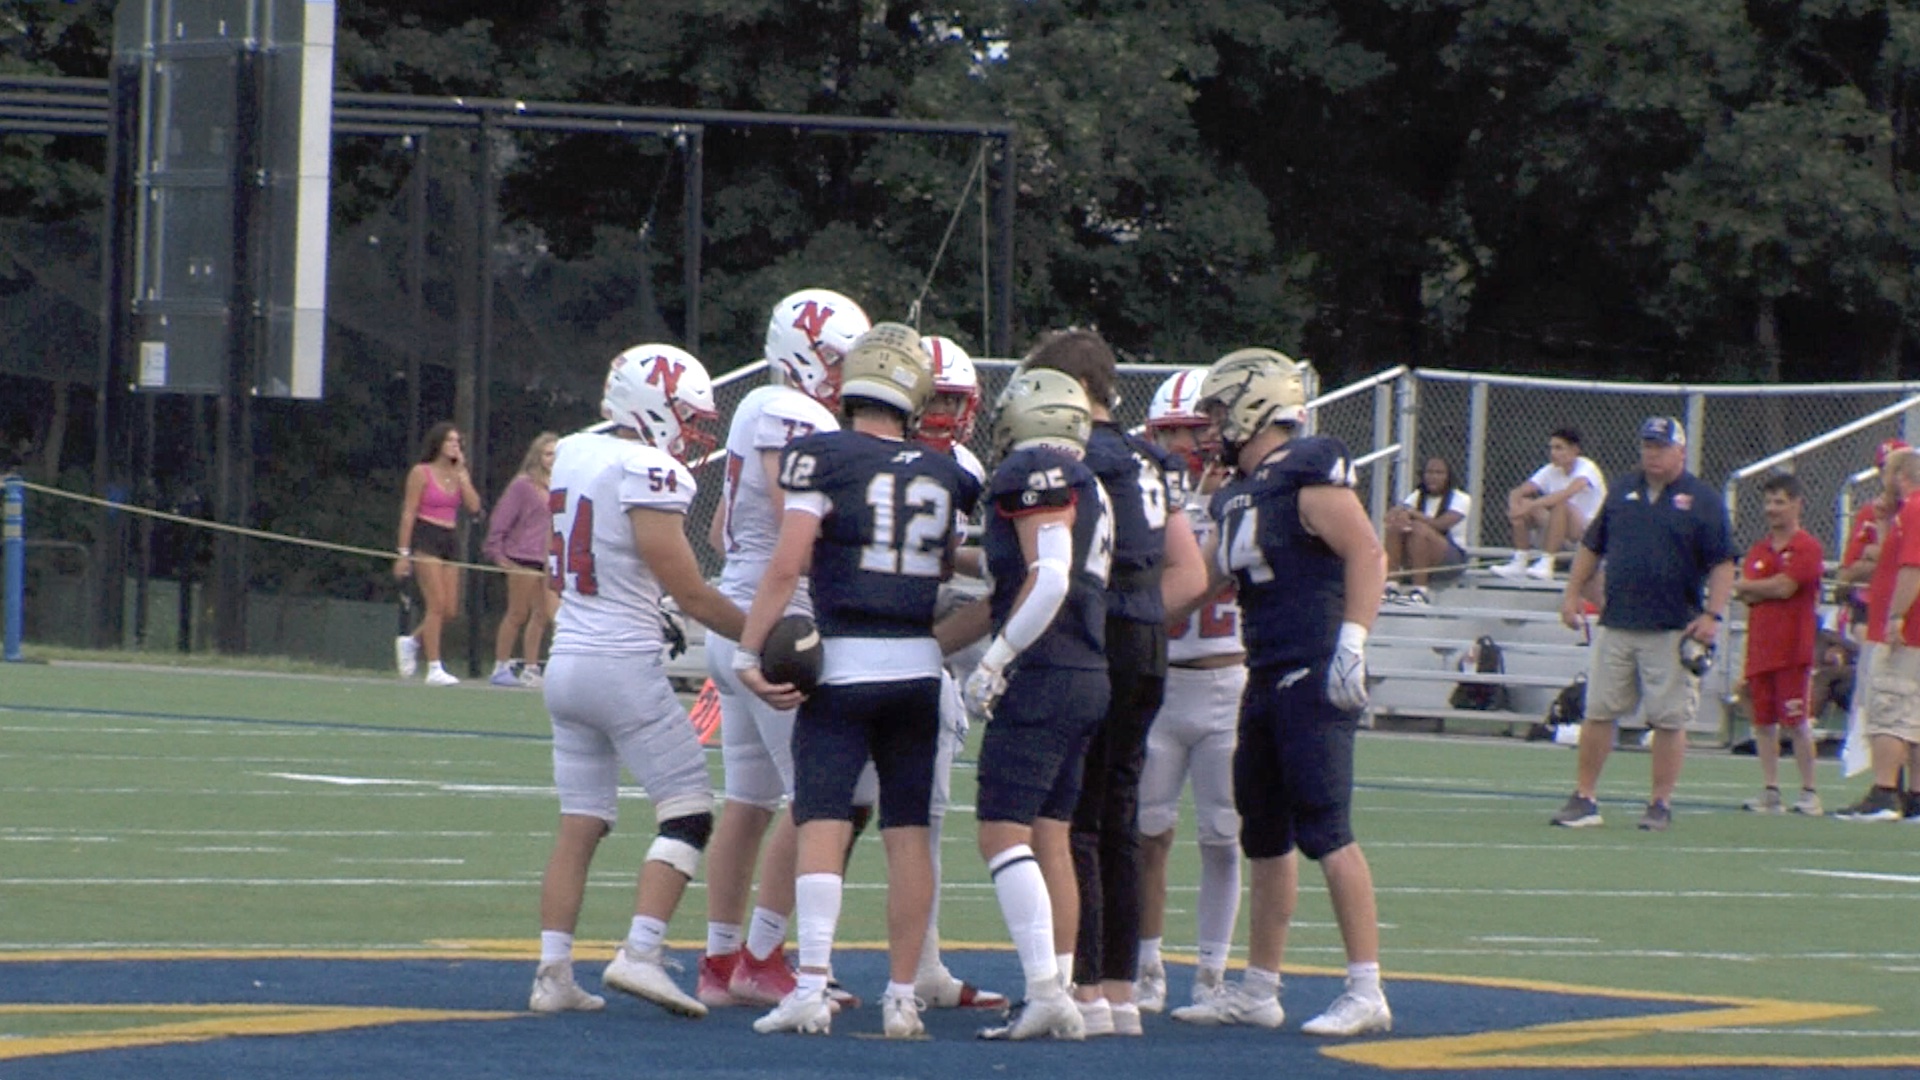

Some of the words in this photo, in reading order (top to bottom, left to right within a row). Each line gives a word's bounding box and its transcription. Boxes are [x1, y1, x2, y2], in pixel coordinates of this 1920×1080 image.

[792, 300, 835, 339] N
[645, 354, 686, 395] N
[648, 467, 678, 493] 54
[780, 451, 818, 488] 12
[548, 487, 598, 596] 54
[858, 473, 950, 577] 12
